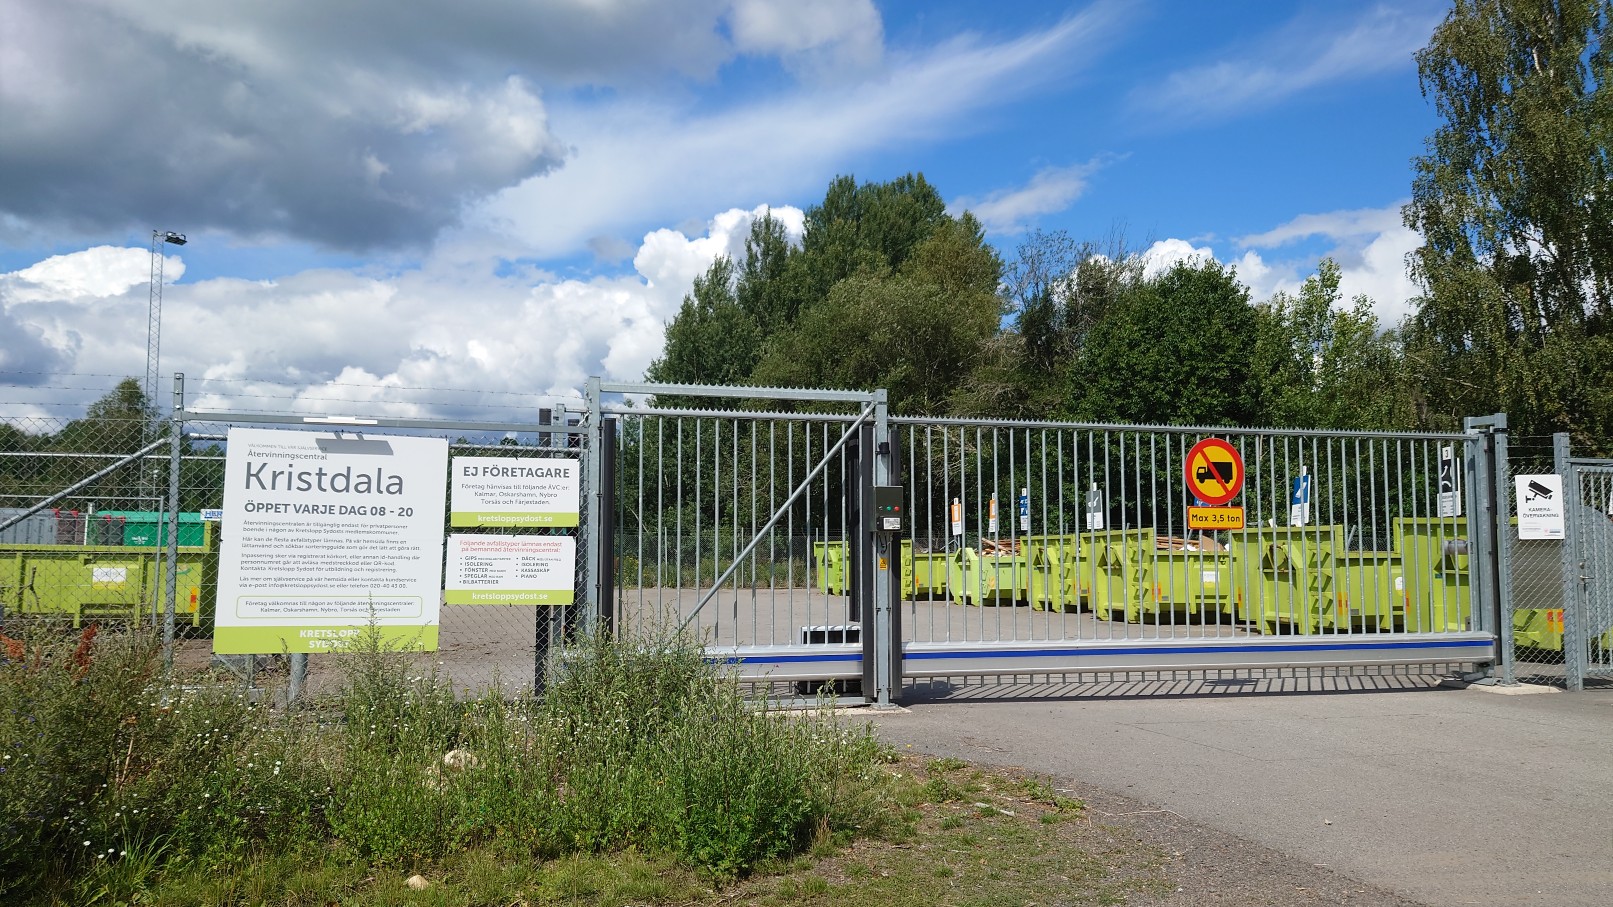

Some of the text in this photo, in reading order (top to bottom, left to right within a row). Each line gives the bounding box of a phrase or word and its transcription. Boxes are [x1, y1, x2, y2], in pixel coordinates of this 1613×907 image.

[248, 449, 327, 460] Återvinningscentral
[464, 465, 570, 478] EJ FÖRETAGARE
[245, 462, 404, 495] Kristdala
[244, 500, 290, 514] ÖPPET
[293, 503, 335, 515] VARJE
[338, 505, 367, 516] DAG
[370, 506, 386, 516] 08
[398, 507, 414, 517] 20
[478, 515, 553, 523] kretsloppsydost.se
[1212, 515, 1224, 523] 3,5
[472, 592, 548, 601] kretsloppsydost.se
[300, 630, 360, 638] KRETSLOPP
